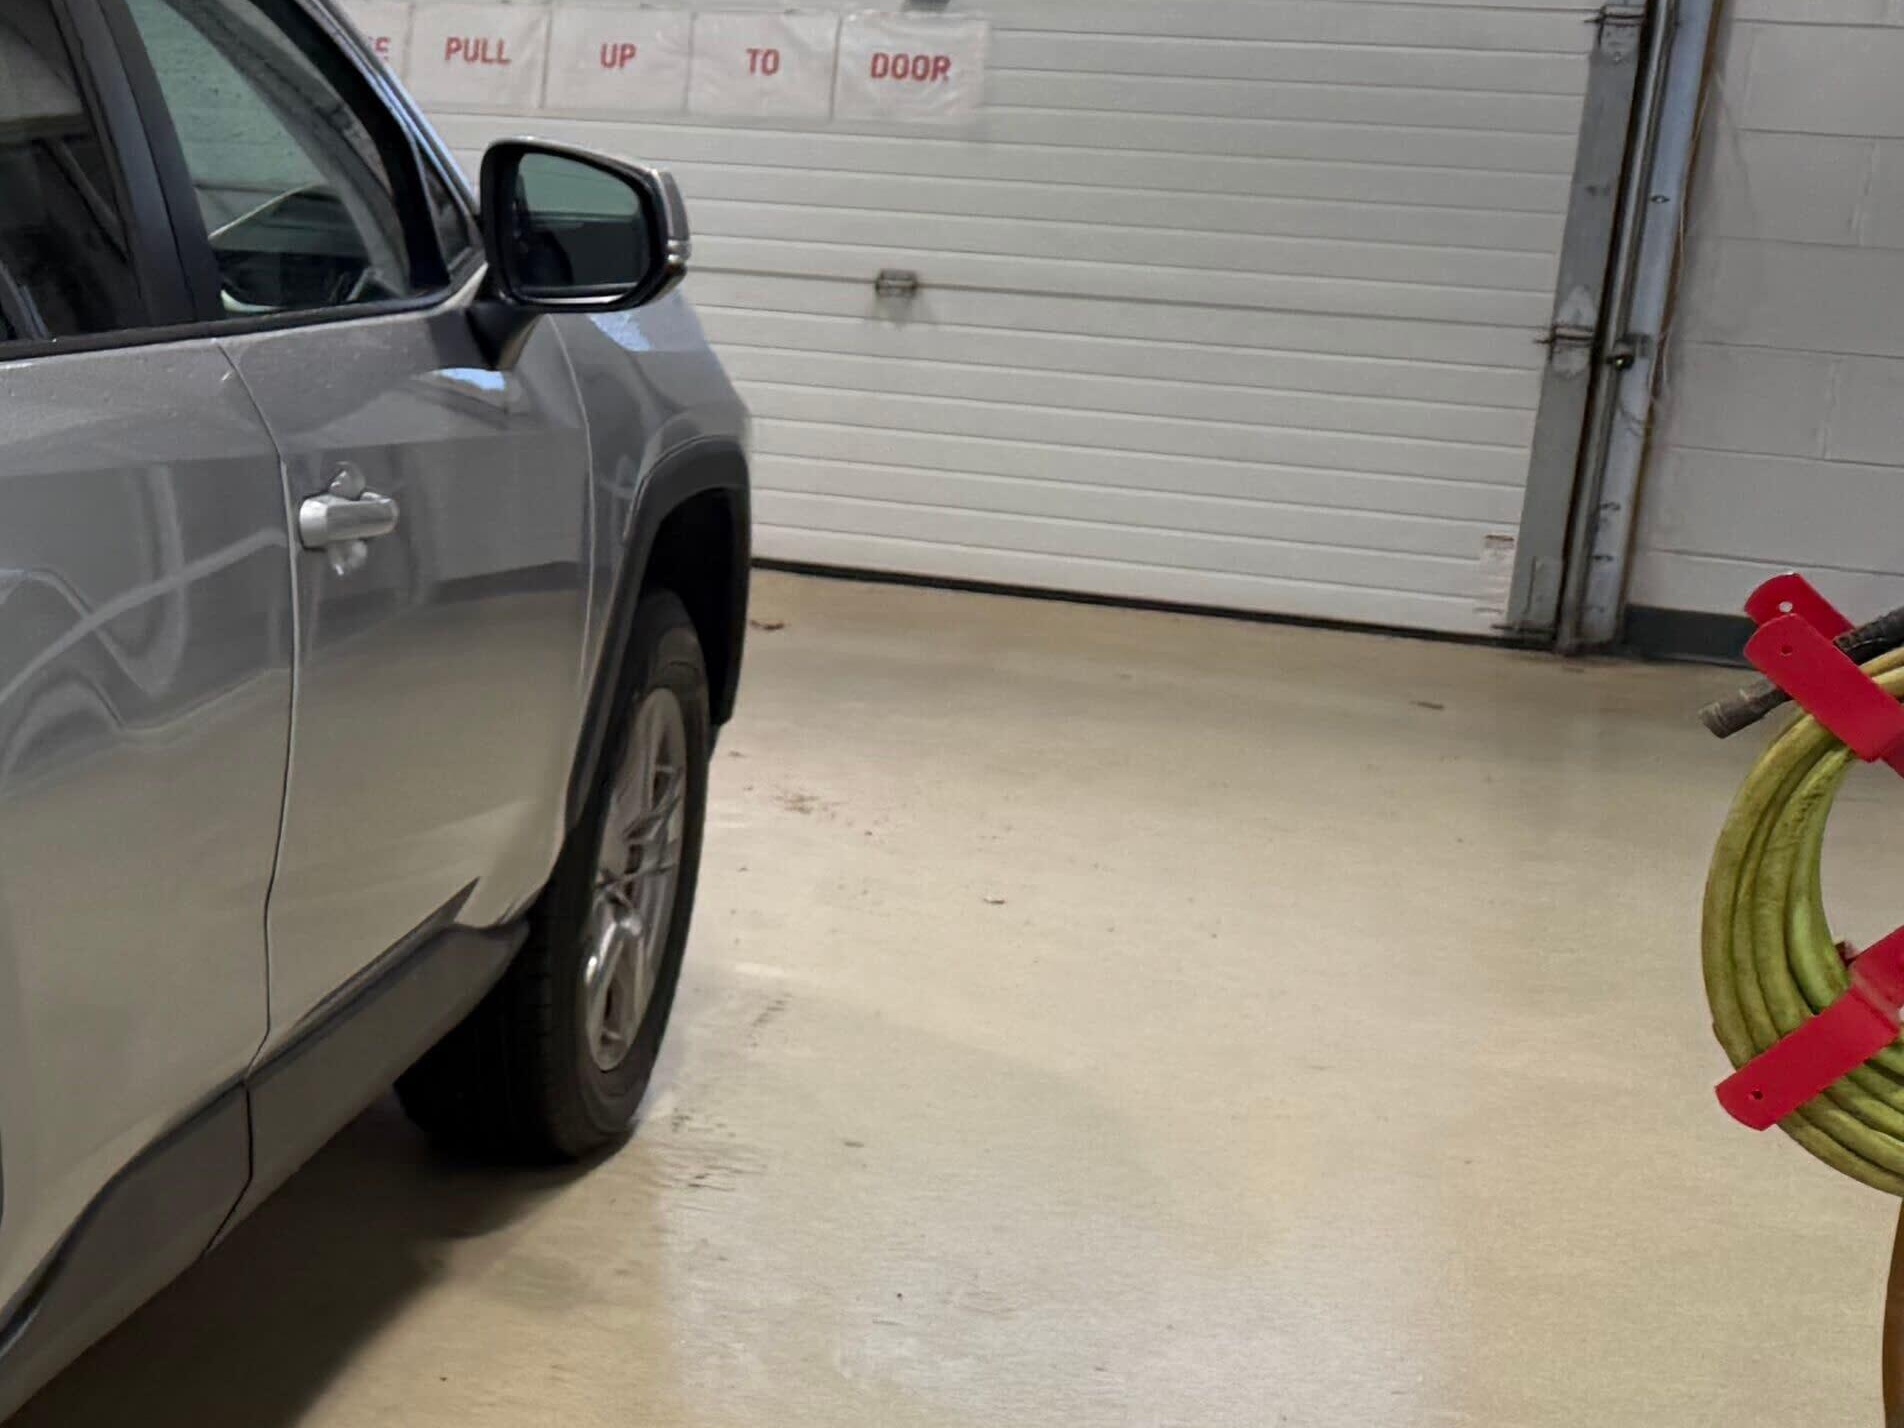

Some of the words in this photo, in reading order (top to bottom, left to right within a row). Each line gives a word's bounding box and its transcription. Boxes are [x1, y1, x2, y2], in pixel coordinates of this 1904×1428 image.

[445, 37, 512, 65] PULL
[600, 43, 637, 69] UP
[746, 48, 781, 76] TO
[870, 52, 952, 82] DOOR
